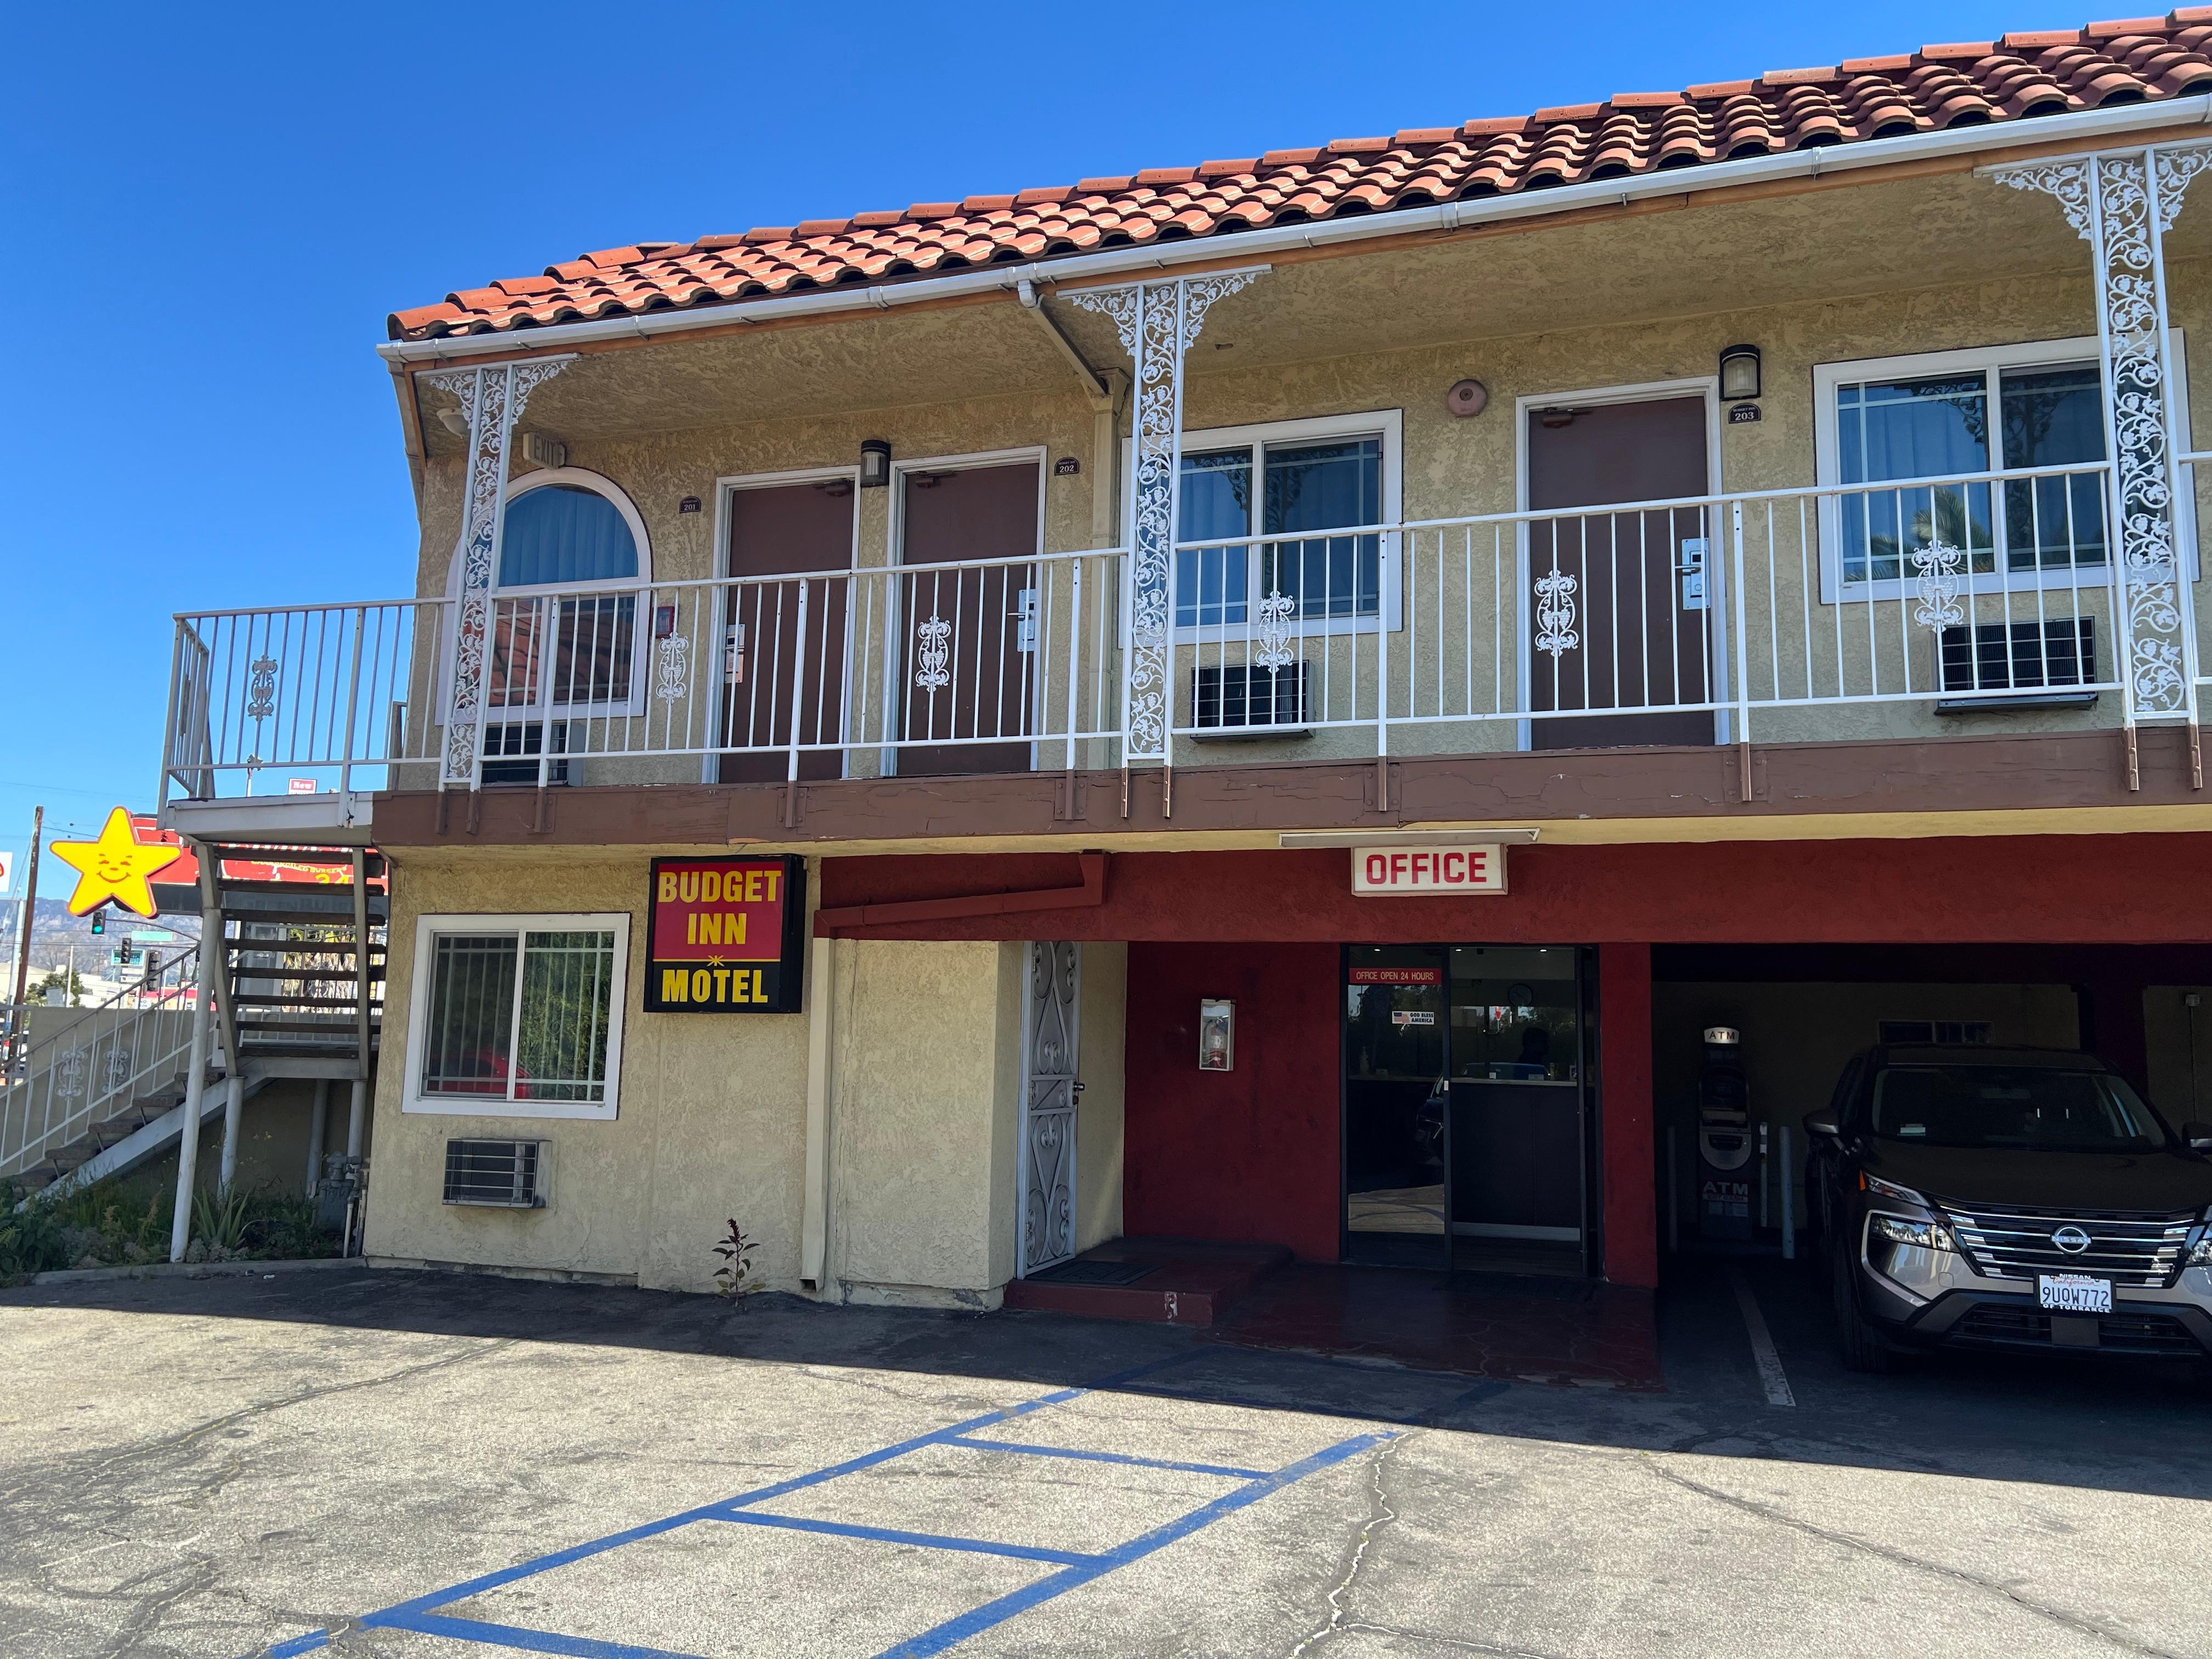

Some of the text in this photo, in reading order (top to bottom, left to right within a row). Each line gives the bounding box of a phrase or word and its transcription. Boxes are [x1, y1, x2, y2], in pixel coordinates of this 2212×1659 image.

[1735, 411, 1754, 421] 203
[534, 434, 555, 466] EXIT
[1059, 465, 1074, 473] 202
[293, 781, 312, 789] New
[1366, 852, 1487, 885] OFFICE
[658, 870, 782, 904] BUDGET
[687, 913, 747, 945] INN
[1356, 971, 1434, 980] OFFICE OPEN 24 HOURS
[661, 969, 769, 1003] MOTEL
[1709, 1030, 1735, 1040] ATM
[1703, 1180, 1748, 1195] ATM
[2052, 1278, 2097, 1286] California
[2042, 1286, 2109, 1307] 9UQW772
[2058, 1304, 2111, 1313] TORRANCE
